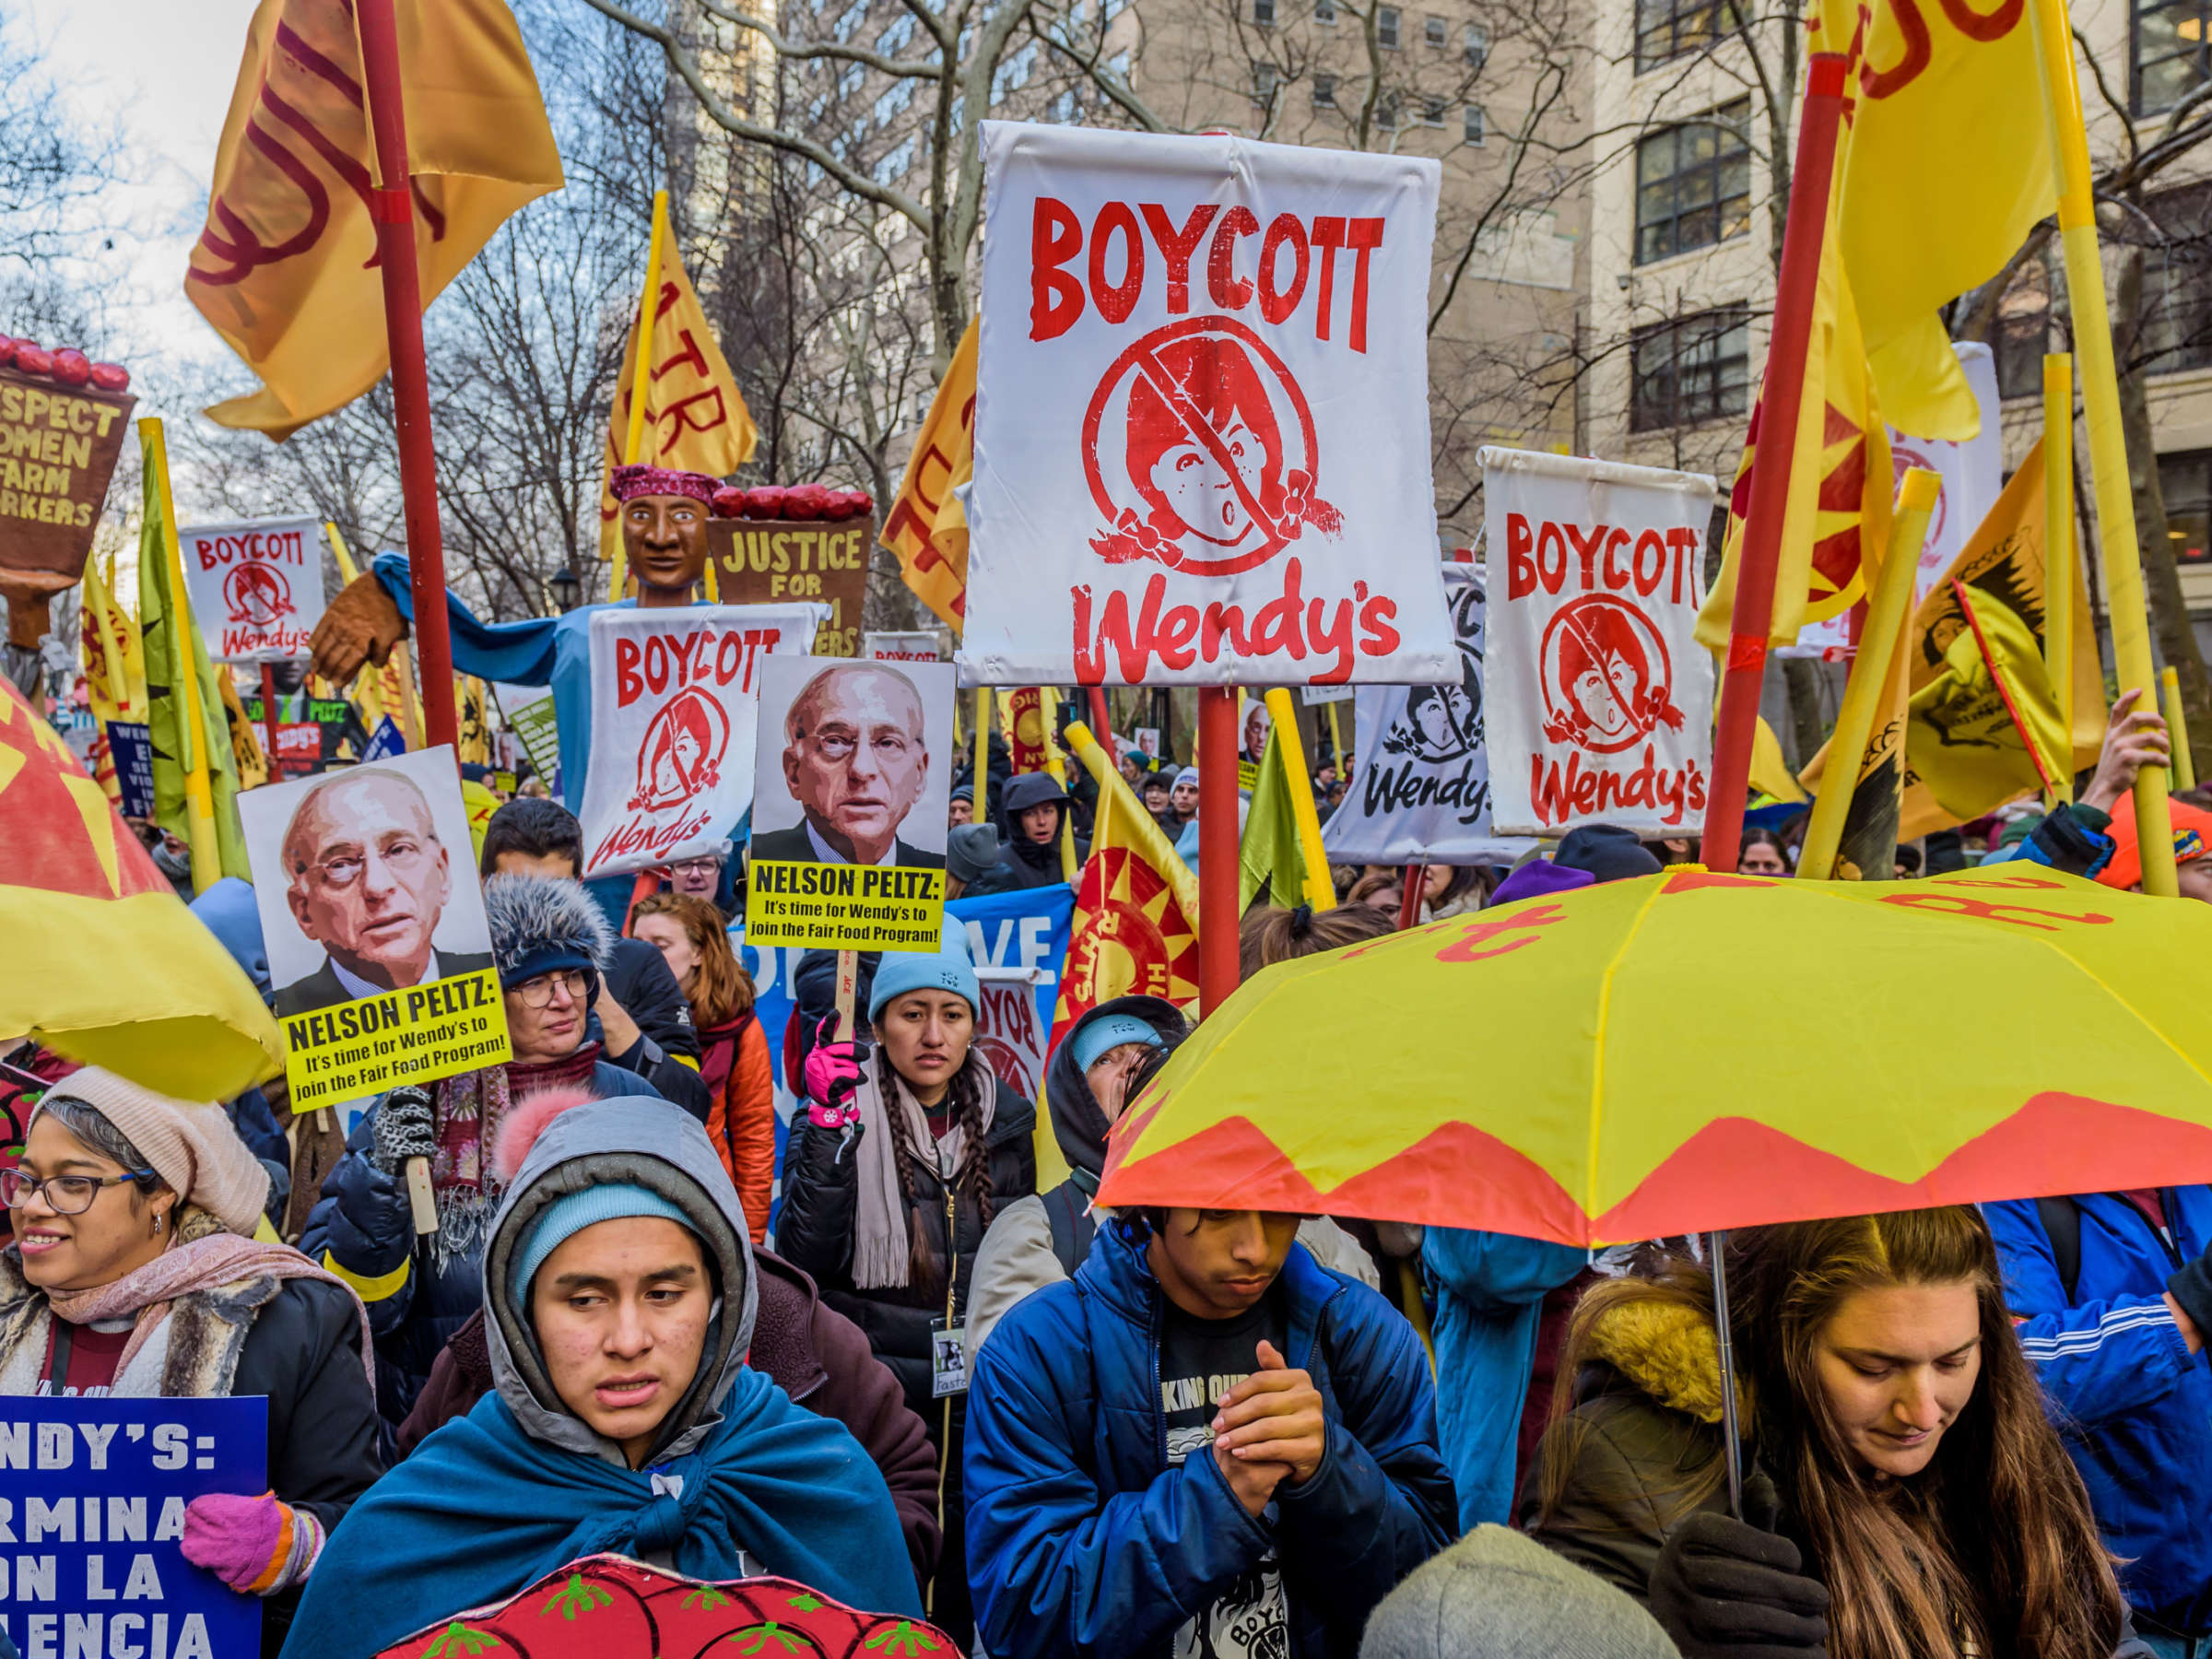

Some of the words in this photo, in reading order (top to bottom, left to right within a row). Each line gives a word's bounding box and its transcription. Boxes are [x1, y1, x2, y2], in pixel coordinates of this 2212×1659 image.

[1030, 196, 1385, 354] BOYCOTT
[0, 384, 122, 438] SPECT
[195, 531, 304, 571] BOYCOTT
[723, 530, 863, 572] JUSTICE
[771, 573, 822, 597] FOR
[222, 621, 310, 658] Wendy's
[1072, 557, 1400, 686] Wendy's
[1364, 759, 1491, 825] Wendy
[1531, 742, 1706, 828] Wendy's
[587, 802, 712, 873] Wendy's
[756, 865, 855, 897] NELSON
[863, 870, 940, 900] PELTZ:
[750, 922, 778, 936] join
[782, 923, 805, 937] the
[807, 924, 834, 938] Fair
[837, 925, 870, 940] Food
[874, 926, 938, 943] Program!
[765, 900, 786, 915] It's
[790, 901, 822, 917] time
[826, 902, 847, 918] for
[849, 904, 910, 922] Wendy's
[912, 908, 927, 922] to
[288, 996, 401, 1053] NELSON
[406, 975, 496, 1022] PELTZ:
[296, 1081, 327, 1101] join
[330, 1073, 356, 1091] the
[360, 1065, 388, 1086] Fair
[392, 1054, 430, 1076] Food
[434, 1034, 506, 1066] Program!
[306, 1054, 331, 1074] It's
[335, 1045, 371, 1067] time
[373, 1039, 396, 1056] for
[399, 1021, 469, 1050] Wendy's
[472, 1017, 488, 1031] to
[0, 1421, 216, 1470] NDY'S:
[87, 1554, 164, 1600] LA
[0, 1613, 214, 1659] ENCIA
